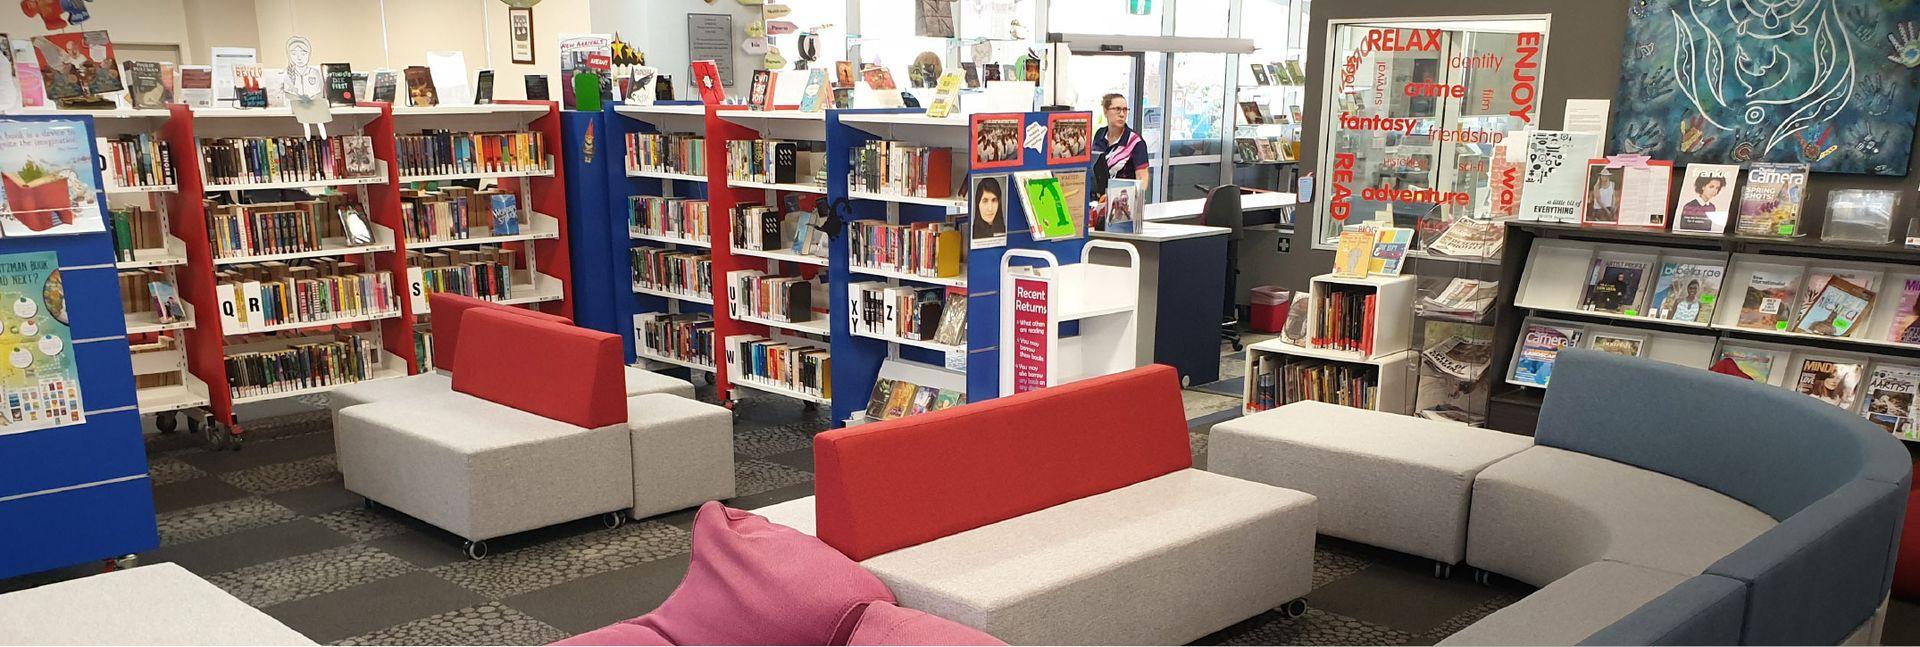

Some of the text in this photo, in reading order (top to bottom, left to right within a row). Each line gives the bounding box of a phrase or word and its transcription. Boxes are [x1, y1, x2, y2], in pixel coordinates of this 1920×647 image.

[1367, 28, 1442, 52] RELAX
[1375, 61, 1387, 106] survival
[1509, 31, 1541, 123] ENJOY
[1404, 78, 1466, 98] crime
[1482, 88, 1494, 111] film
[1339, 111, 1416, 136] fantasy
[1428, 125, 1504, 145] friendship
[1459, 160, 1484, 173] sci-fi
[1748, 168, 1804, 185] Camera
[1329, 152, 1356, 221] READ
[1361, 183, 1470, 206] adventure
[1500, 167, 1517, 216] war
[1533, 205, 1574, 215] EVERYTHING
[0, 260, 49, 273] TZMAN BOOK
[12, 273, 39, 285] NEXT?
[412, 281, 421, 297] S
[729, 286, 736, 301] U
[1017, 286, 1046, 301] Recent
[222, 300, 235, 317] Q
[248, 297, 260, 313] R
[730, 302, 737, 317] V
[851, 300, 859, 316] X
[886, 304, 893, 321] Z
[1015, 299, 1047, 315] Returns
[851, 316, 859, 333] Y
[635, 327, 641, 340] T
[1525, 331, 1569, 347] Camera
[727, 349, 735, 364] W
